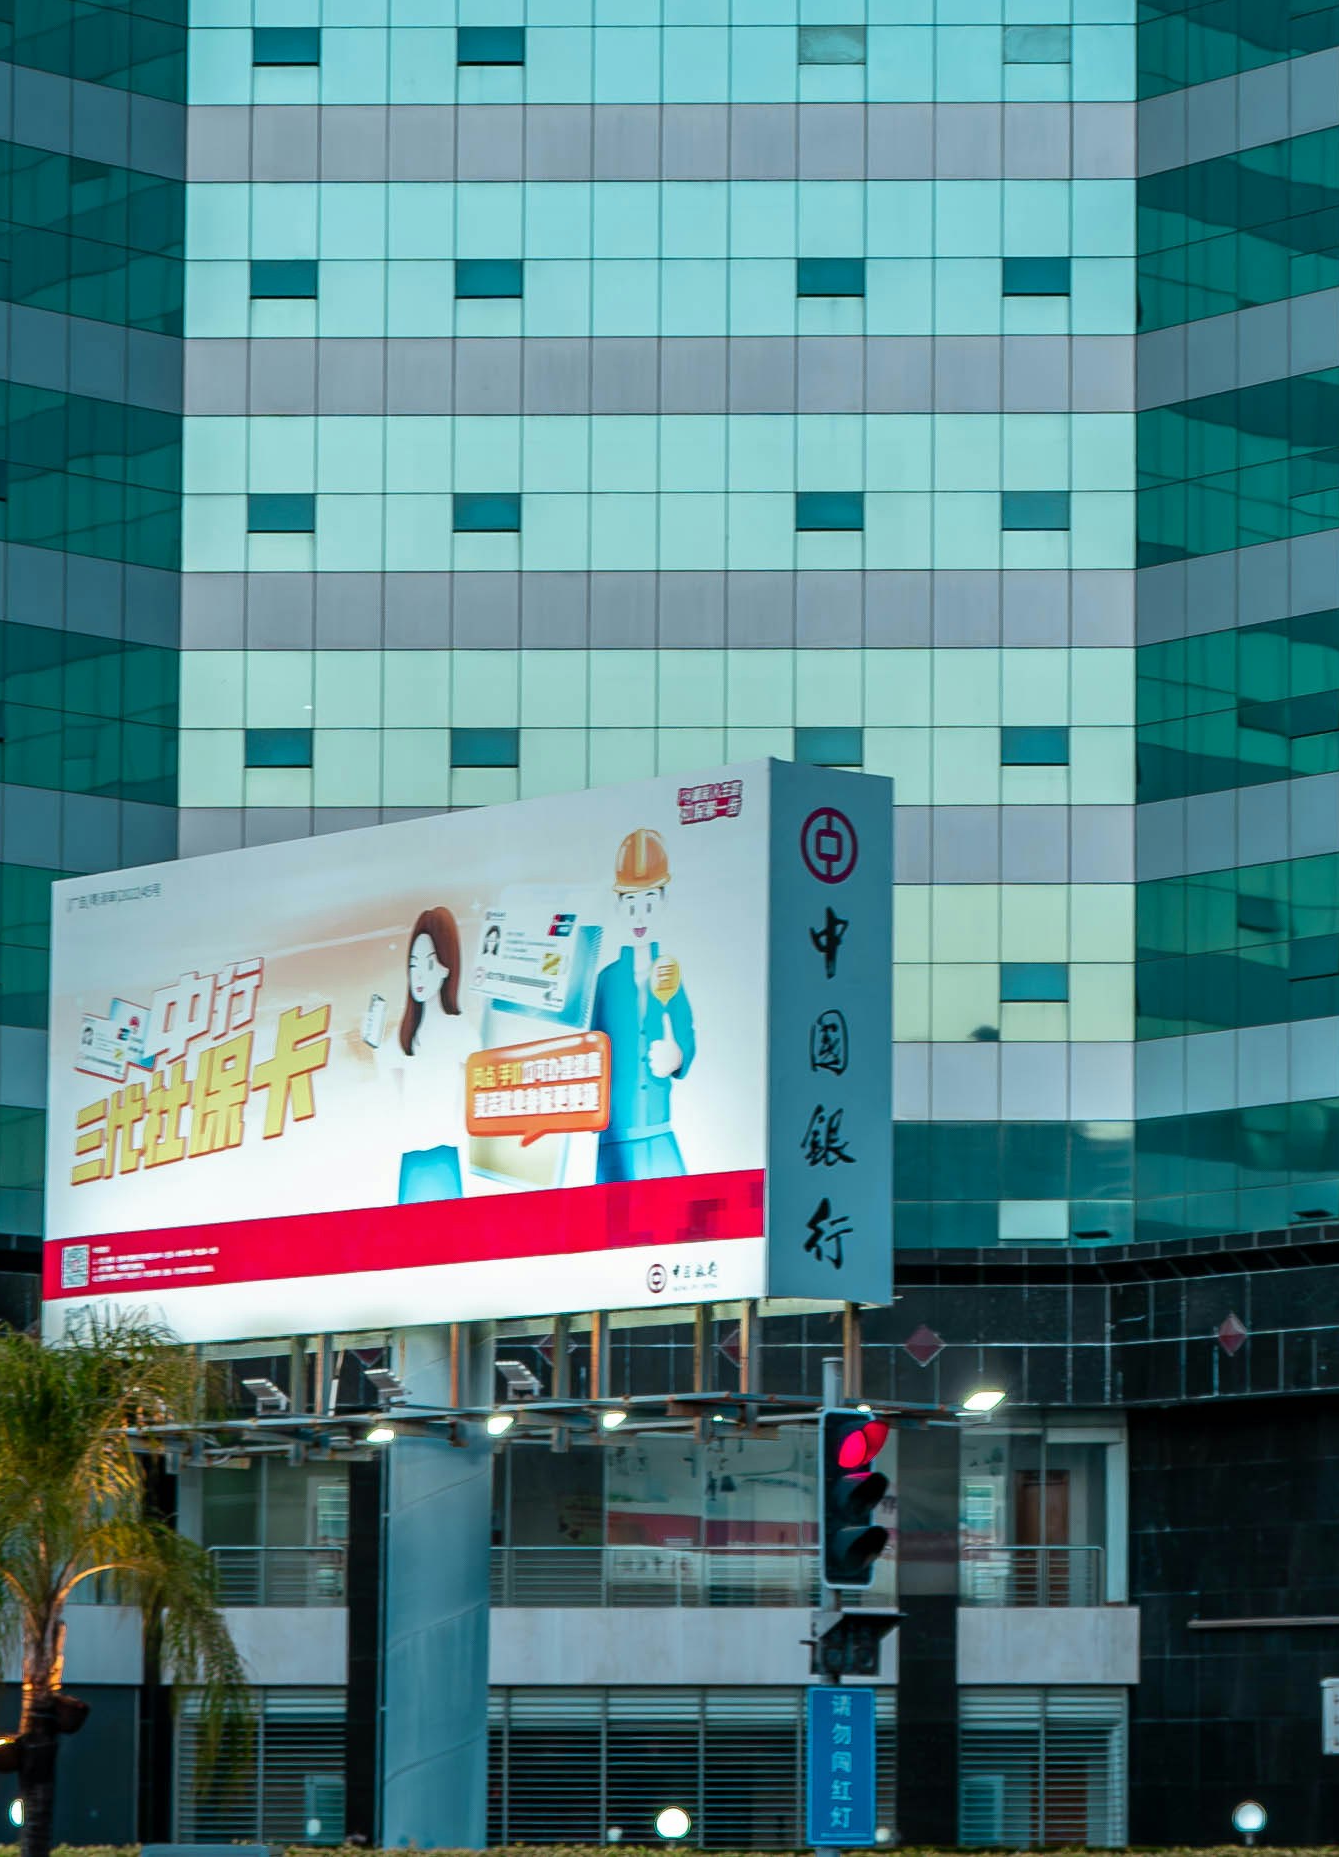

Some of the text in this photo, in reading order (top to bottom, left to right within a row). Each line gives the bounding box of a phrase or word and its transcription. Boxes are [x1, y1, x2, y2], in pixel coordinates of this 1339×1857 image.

[151, 957, 264, 1065] 中行
[70, 1003, 332, 1187] 三代社保卡
[830, 1694, 854, 1830] 请勿闯红灯
